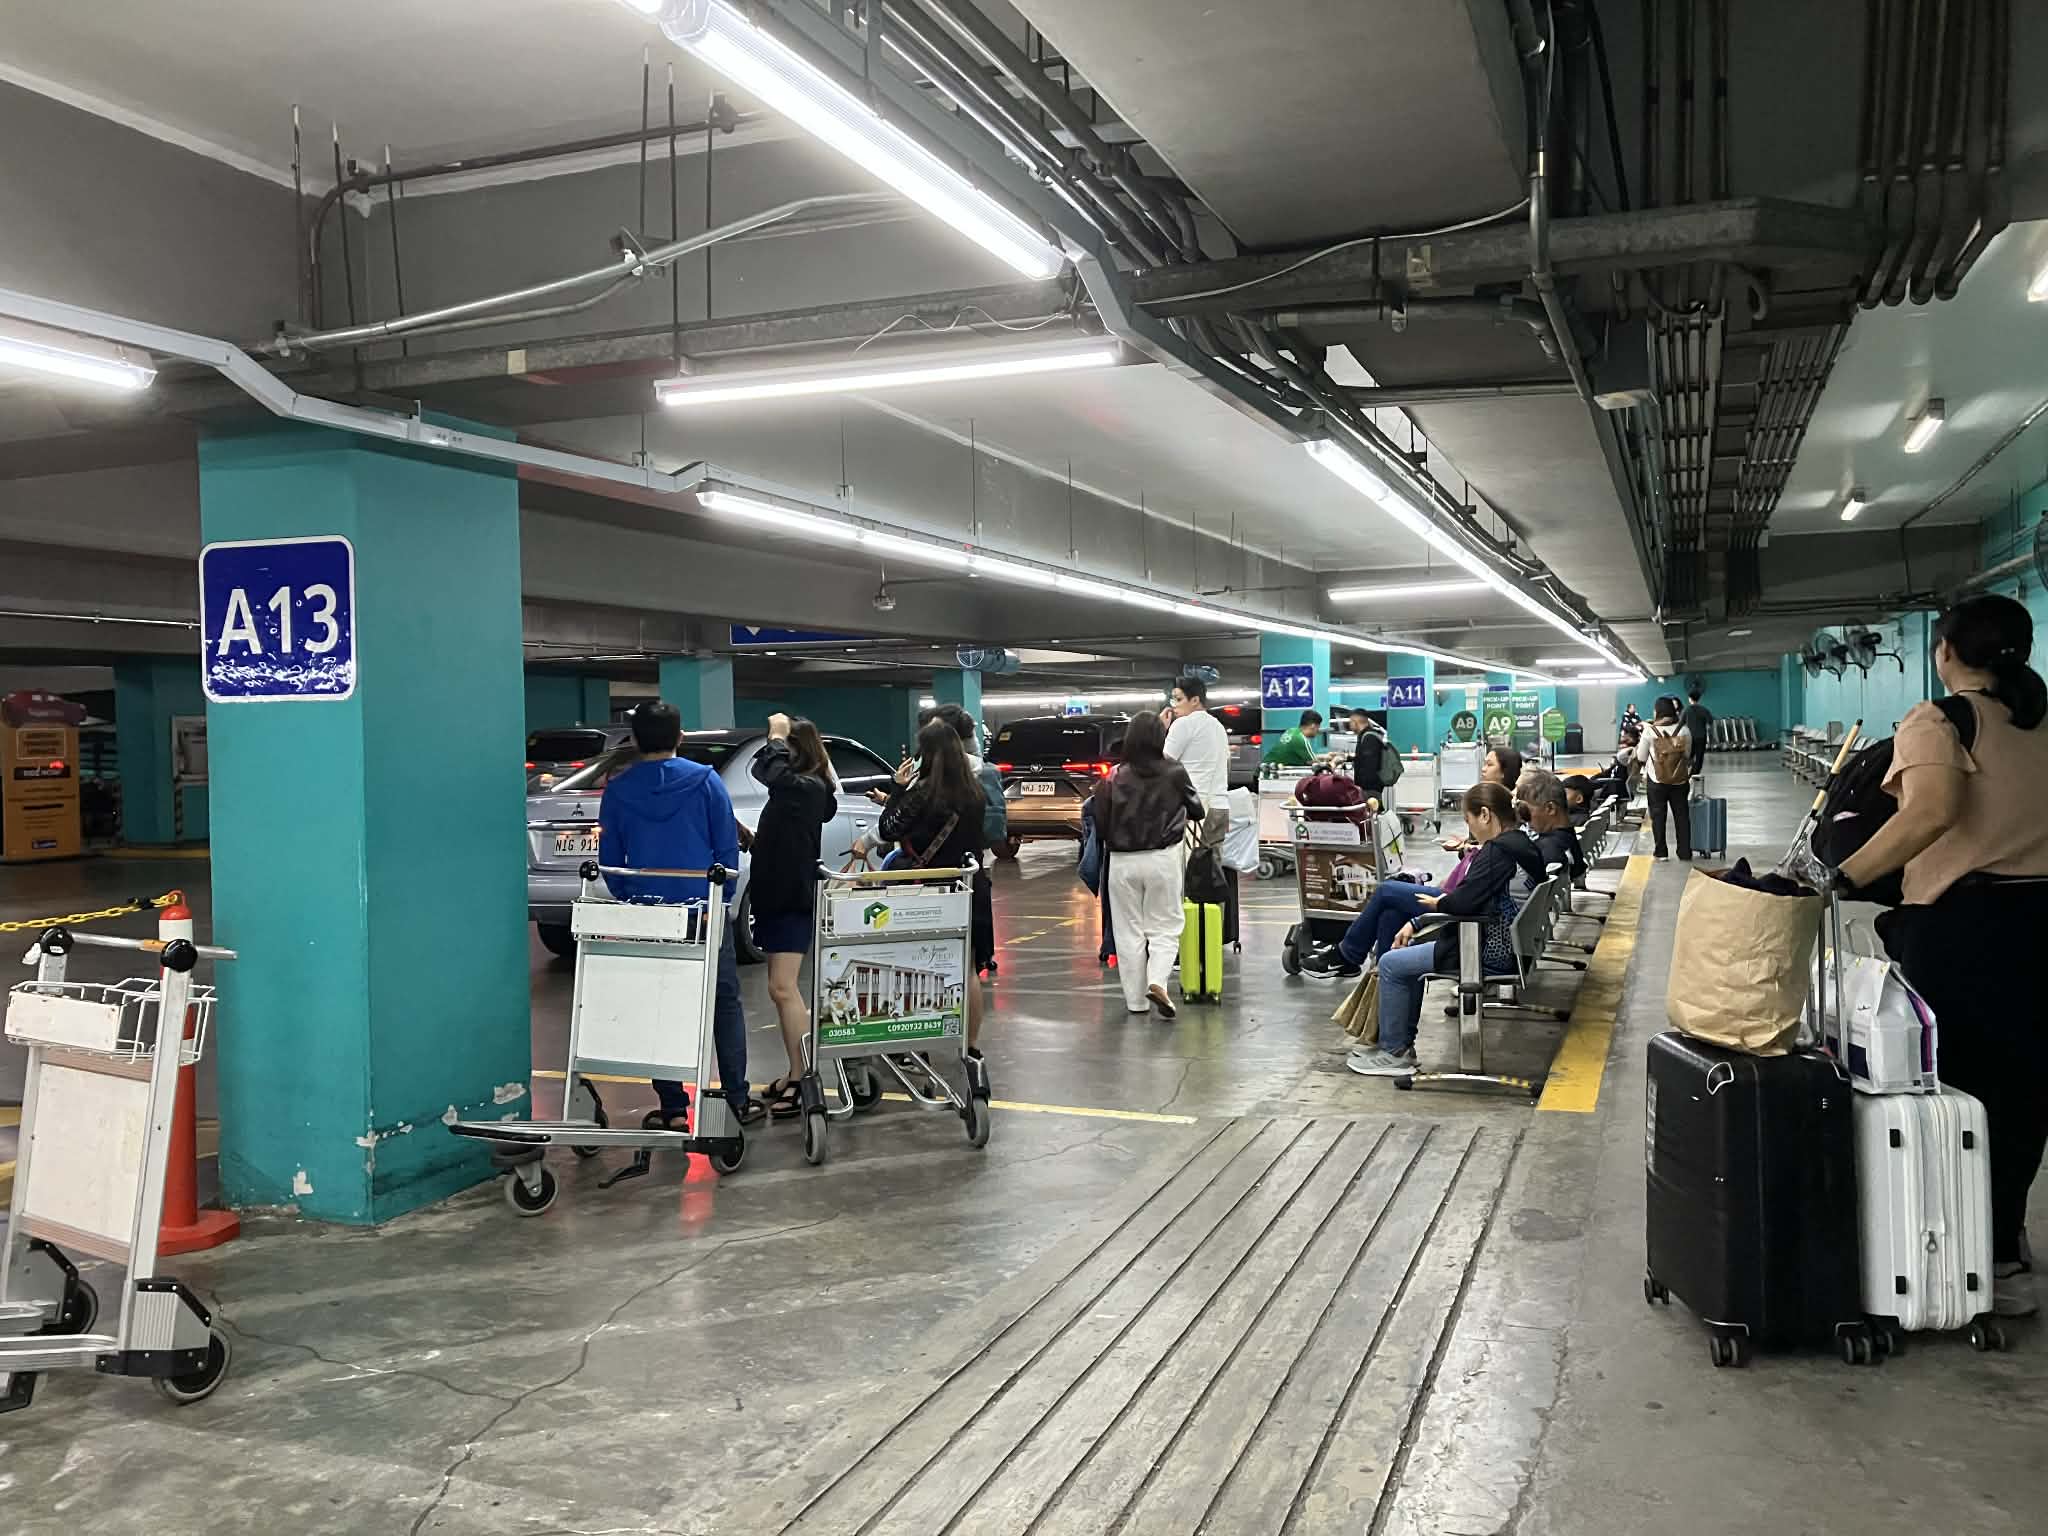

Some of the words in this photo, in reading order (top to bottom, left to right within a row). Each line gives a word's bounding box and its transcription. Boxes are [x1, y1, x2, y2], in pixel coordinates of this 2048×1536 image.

[217, 583, 339, 656] A13
[1266, 676, 1310, 698] A12
[1392, 685, 1422, 701] A11
[1456, 717, 1475, 729] A8
[1488, 716, 1512, 731] A9
[555, 839, 575, 851] NIG
